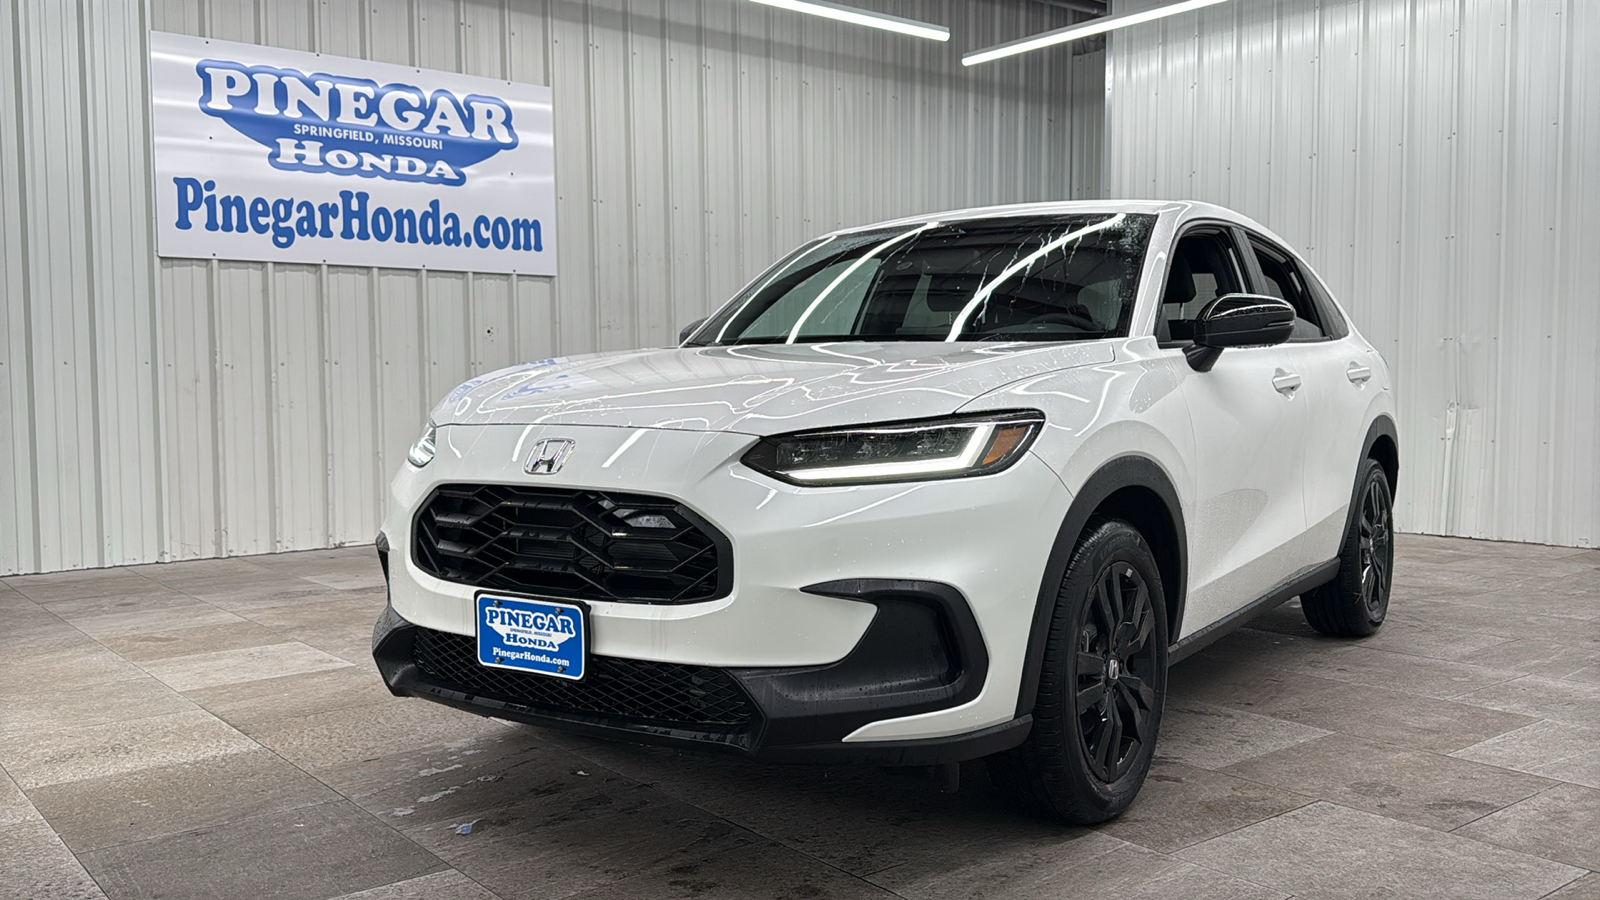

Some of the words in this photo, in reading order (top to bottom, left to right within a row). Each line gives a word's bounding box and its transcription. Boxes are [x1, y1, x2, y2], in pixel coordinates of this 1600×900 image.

[203, 66, 514, 145] PINEGAR
[293, 123, 380, 145] SPRINGFIELD,
[382, 133, 444, 151] MISSOURI
[274, 138, 460, 180] HONDA
[172, 176, 543, 253] PinegarHonda.com
[487, 608, 575, 635] PINEGAR
[505, 632, 557, 649] HONDA
[492, 646, 570, 667] PinegarHonda.com
